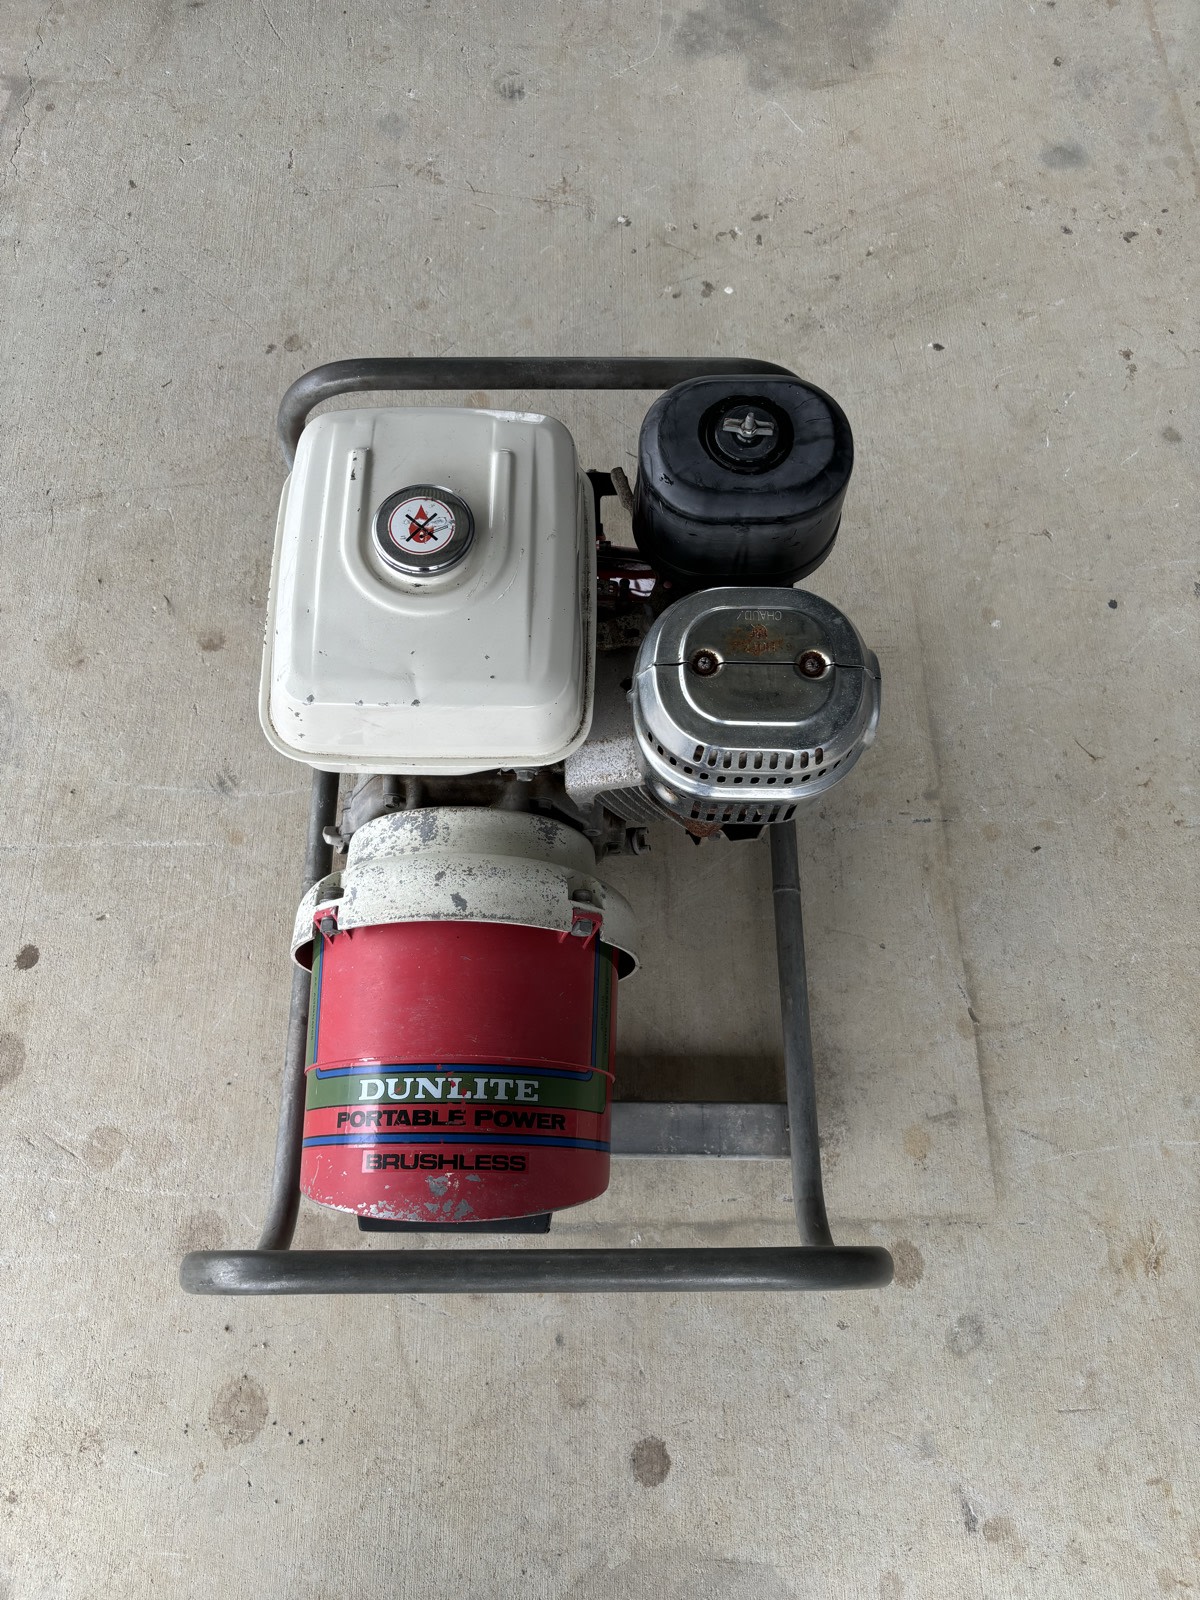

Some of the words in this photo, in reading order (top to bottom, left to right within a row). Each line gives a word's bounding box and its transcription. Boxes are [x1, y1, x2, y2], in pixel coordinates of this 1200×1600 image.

[358, 1077, 539, 1102] DUNLITE
[336, 1109, 467, 1129] PORTABLE
[474, 1109, 566, 1131] POWER
[365, 1153, 527, 1172] BRUSHLESS
